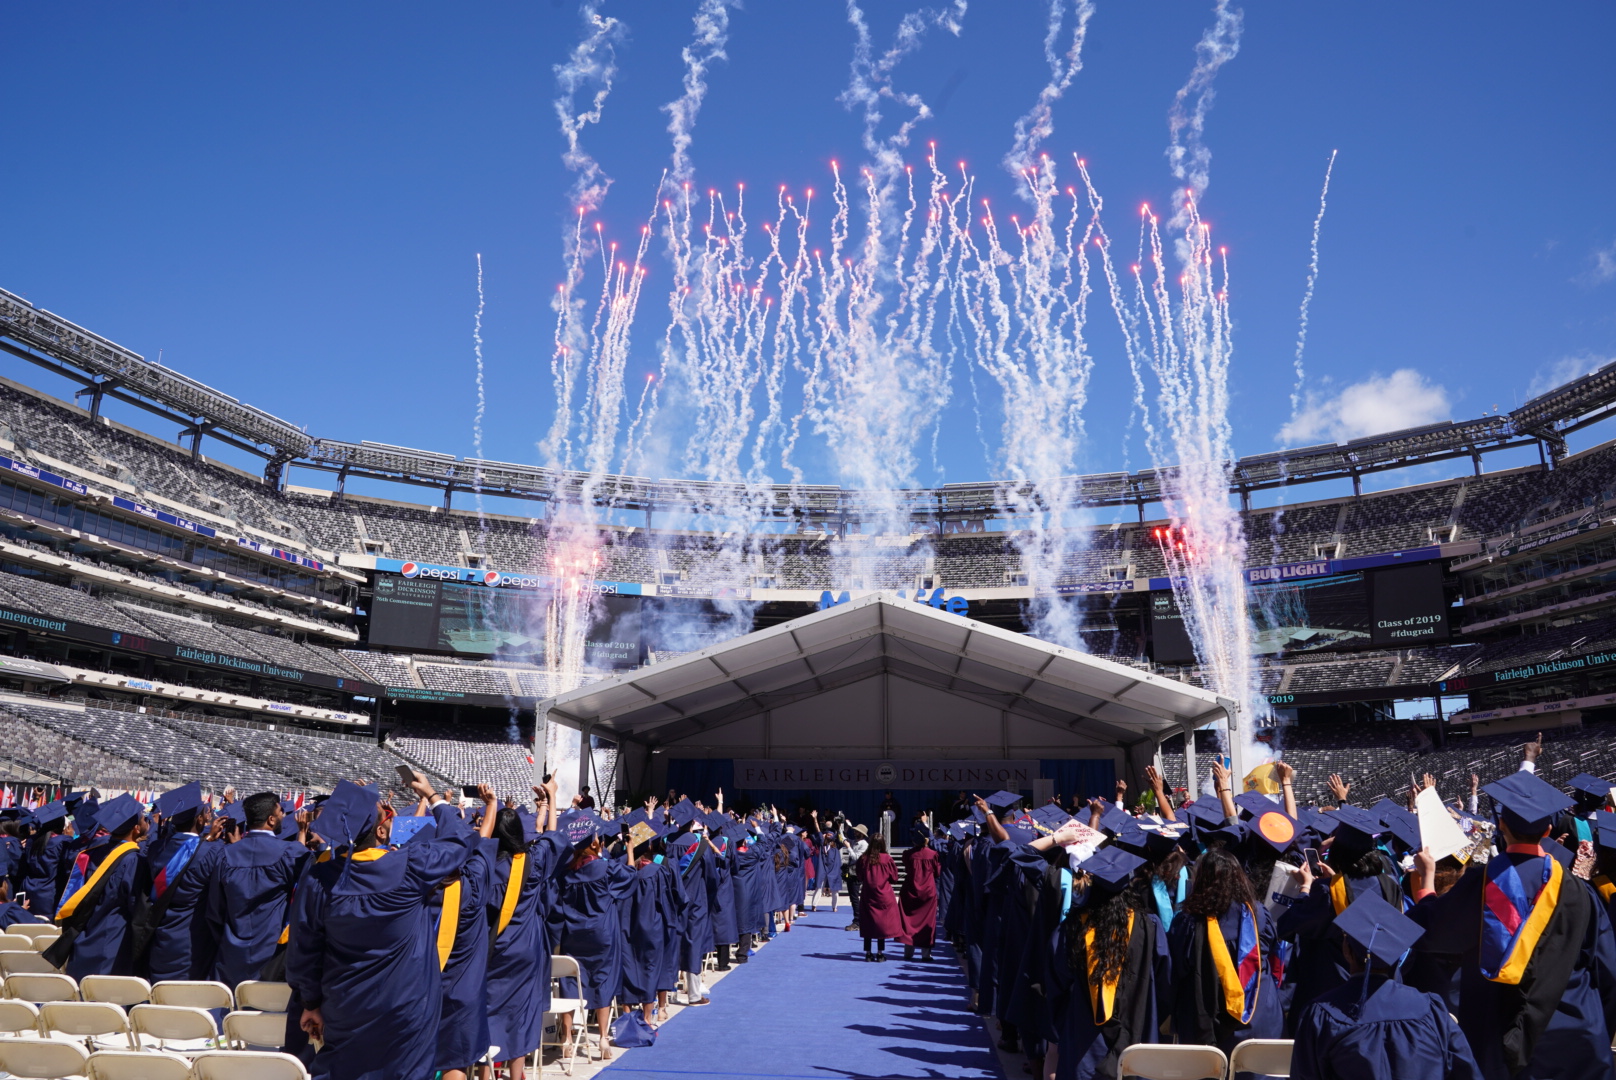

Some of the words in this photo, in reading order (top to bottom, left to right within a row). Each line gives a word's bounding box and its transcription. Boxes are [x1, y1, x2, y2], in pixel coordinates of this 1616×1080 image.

[1518, 542, 1537, 552] RING
[1550, 529, 1578, 541] HONOR
[420, 568, 460, 580] pepsi
[1250, 568, 1281, 581] BUD
[1282, 563, 1327, 578] LIGHT
[398, 580, 437, 589] FAIRLEIGH
[501, 574, 540, 588] pepsi
[397, 586, 436, 595] DICKINSON
[580, 582, 618, 594] pepsi
[390, 598, 433, 607] Commencement
[1404, 617, 1414, 625] of
[1416, 614, 1441, 624] 2019
[1390, 627, 1434, 637] #fdugrad
[176, 646, 216, 663] Fairleigh
[218, 655, 260, 672] Dickinson
[263, 664, 304, 681] University
[1495, 666, 1534, 681] Fairleigh
[1536, 659, 1584, 674] Dickinson
[1271, 695, 1294, 703] 2019
[746, 769, 870, 782] FAIRLEIGH
[902, 768, 1028, 782] DICKINSON
